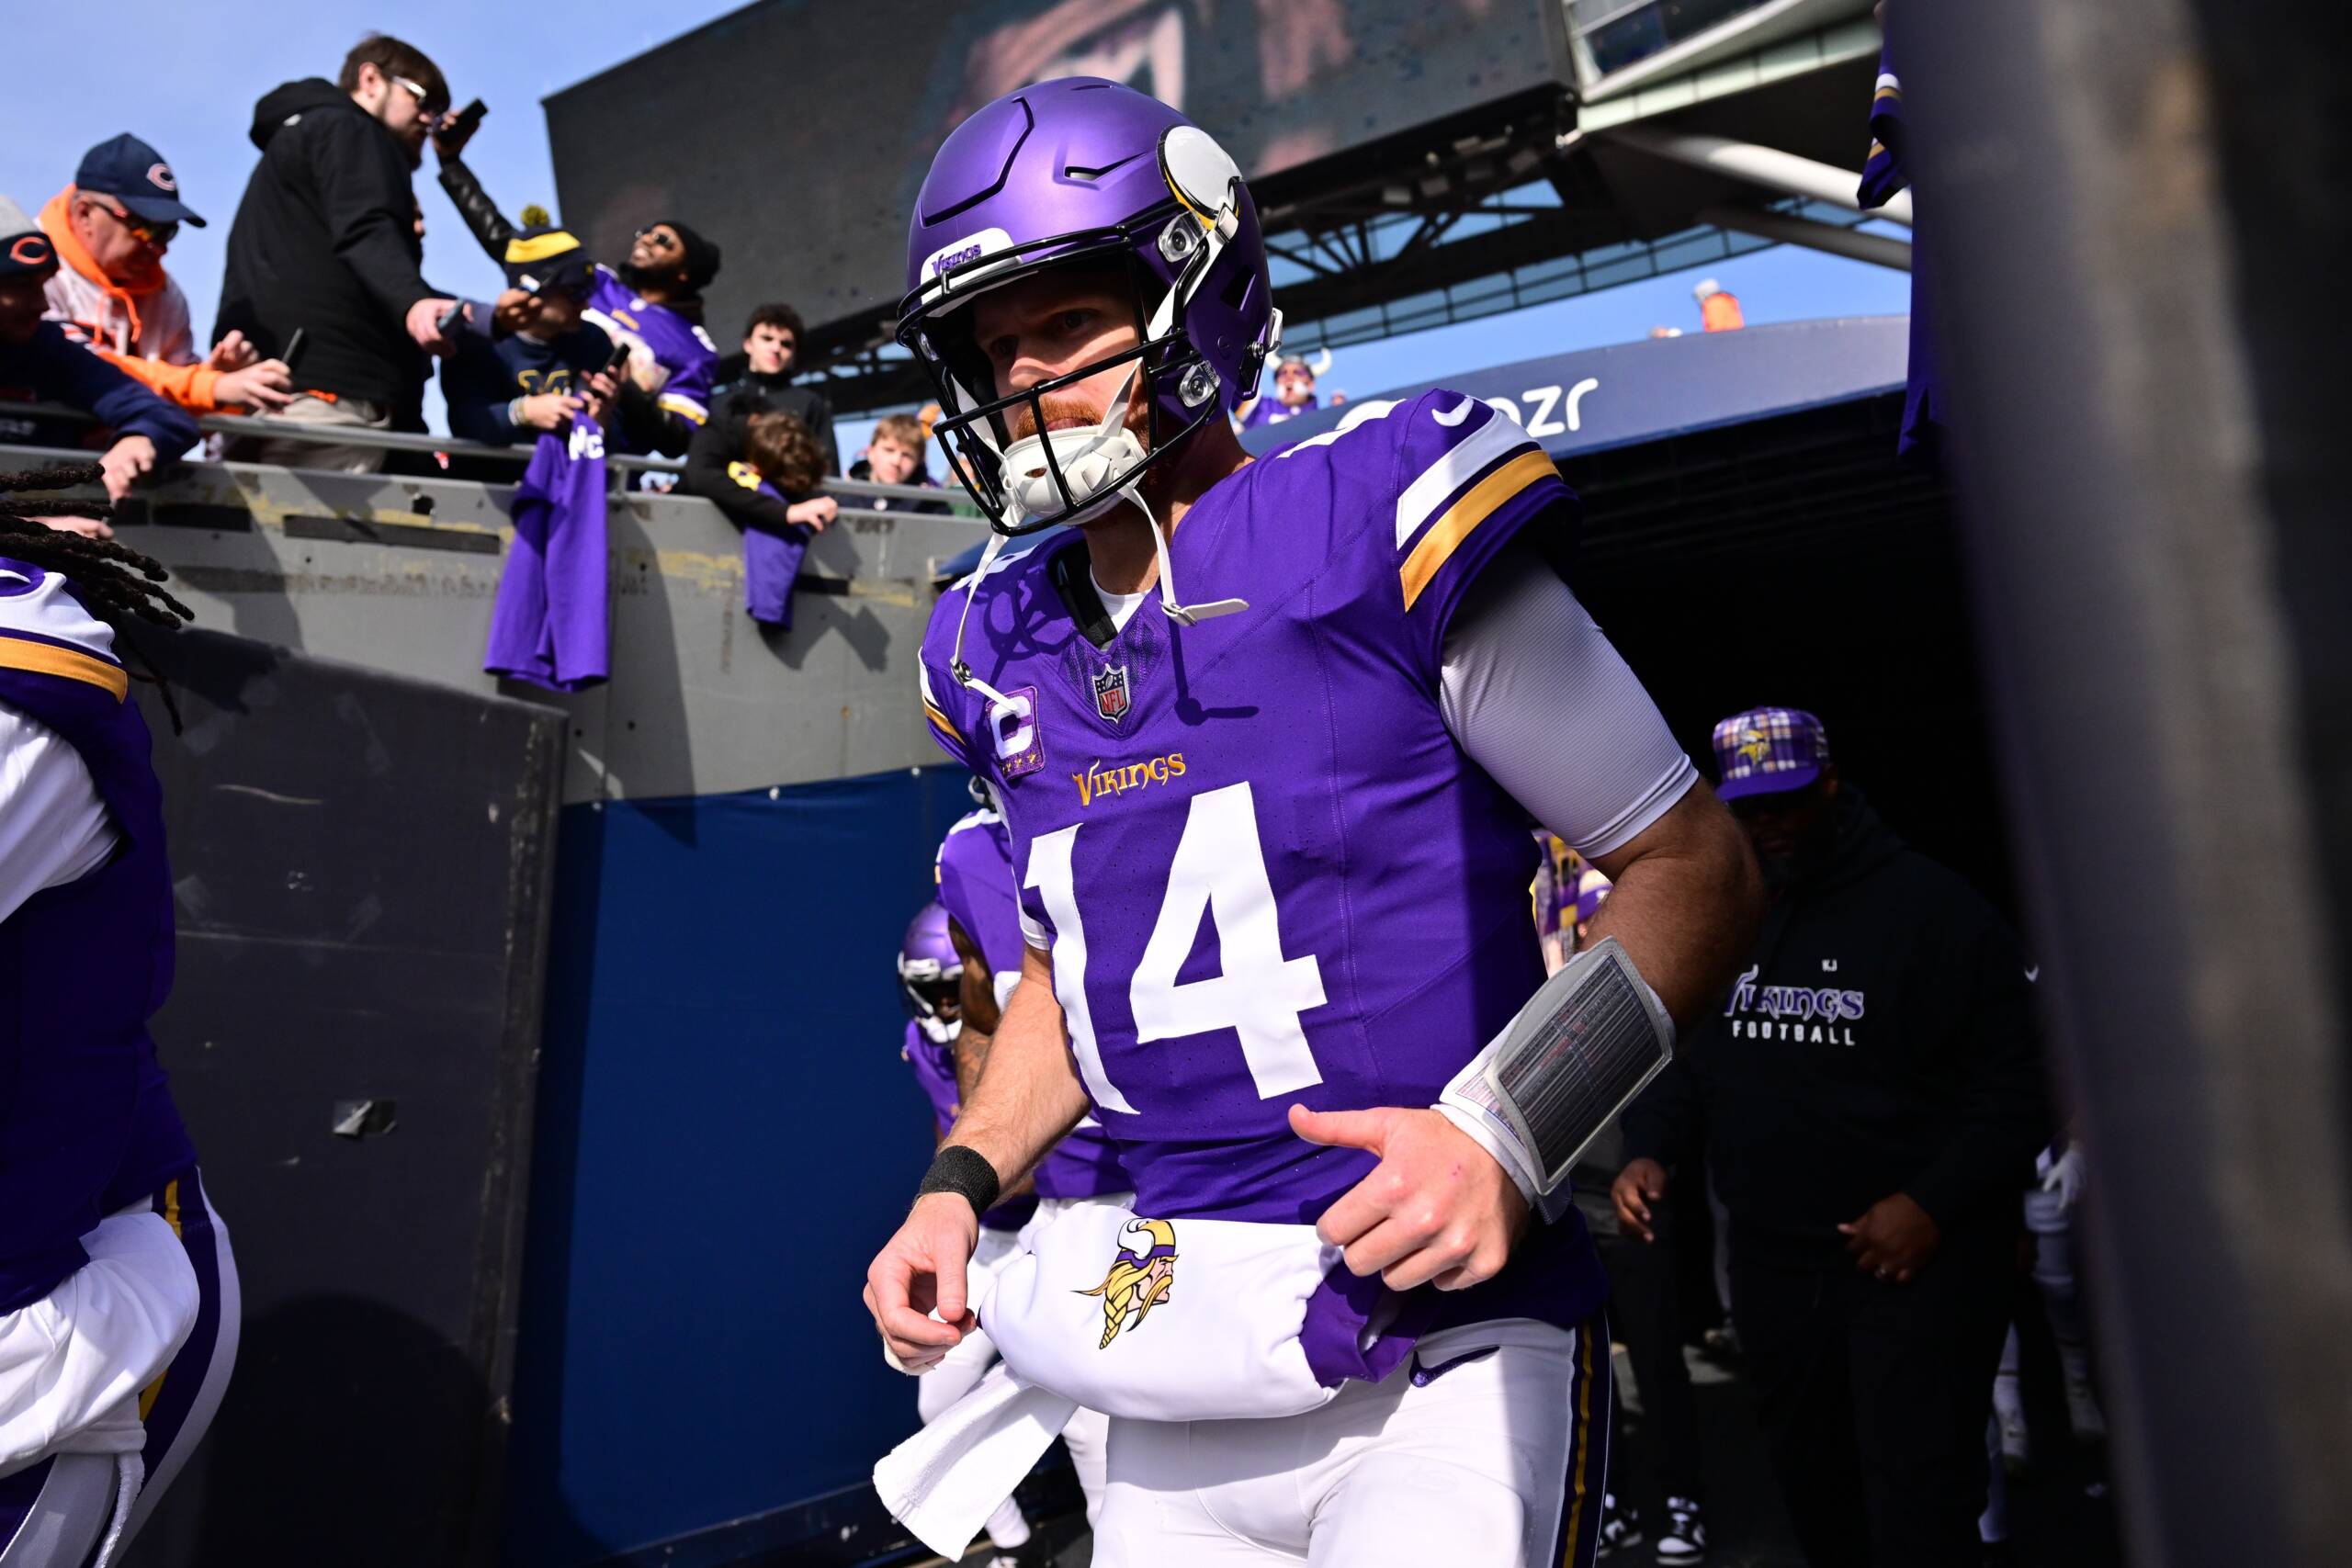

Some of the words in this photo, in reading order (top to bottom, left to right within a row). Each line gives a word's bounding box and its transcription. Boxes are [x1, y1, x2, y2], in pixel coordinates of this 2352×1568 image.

[146, 163, 176, 192] C
[9, 236, 51, 265] C
[1101, 689, 1126, 714] NFL
[990, 695, 1034, 760] C
[1023, 780, 1329, 1116] 14
[1731, 1020, 1856, 1046] FOOTBALL
